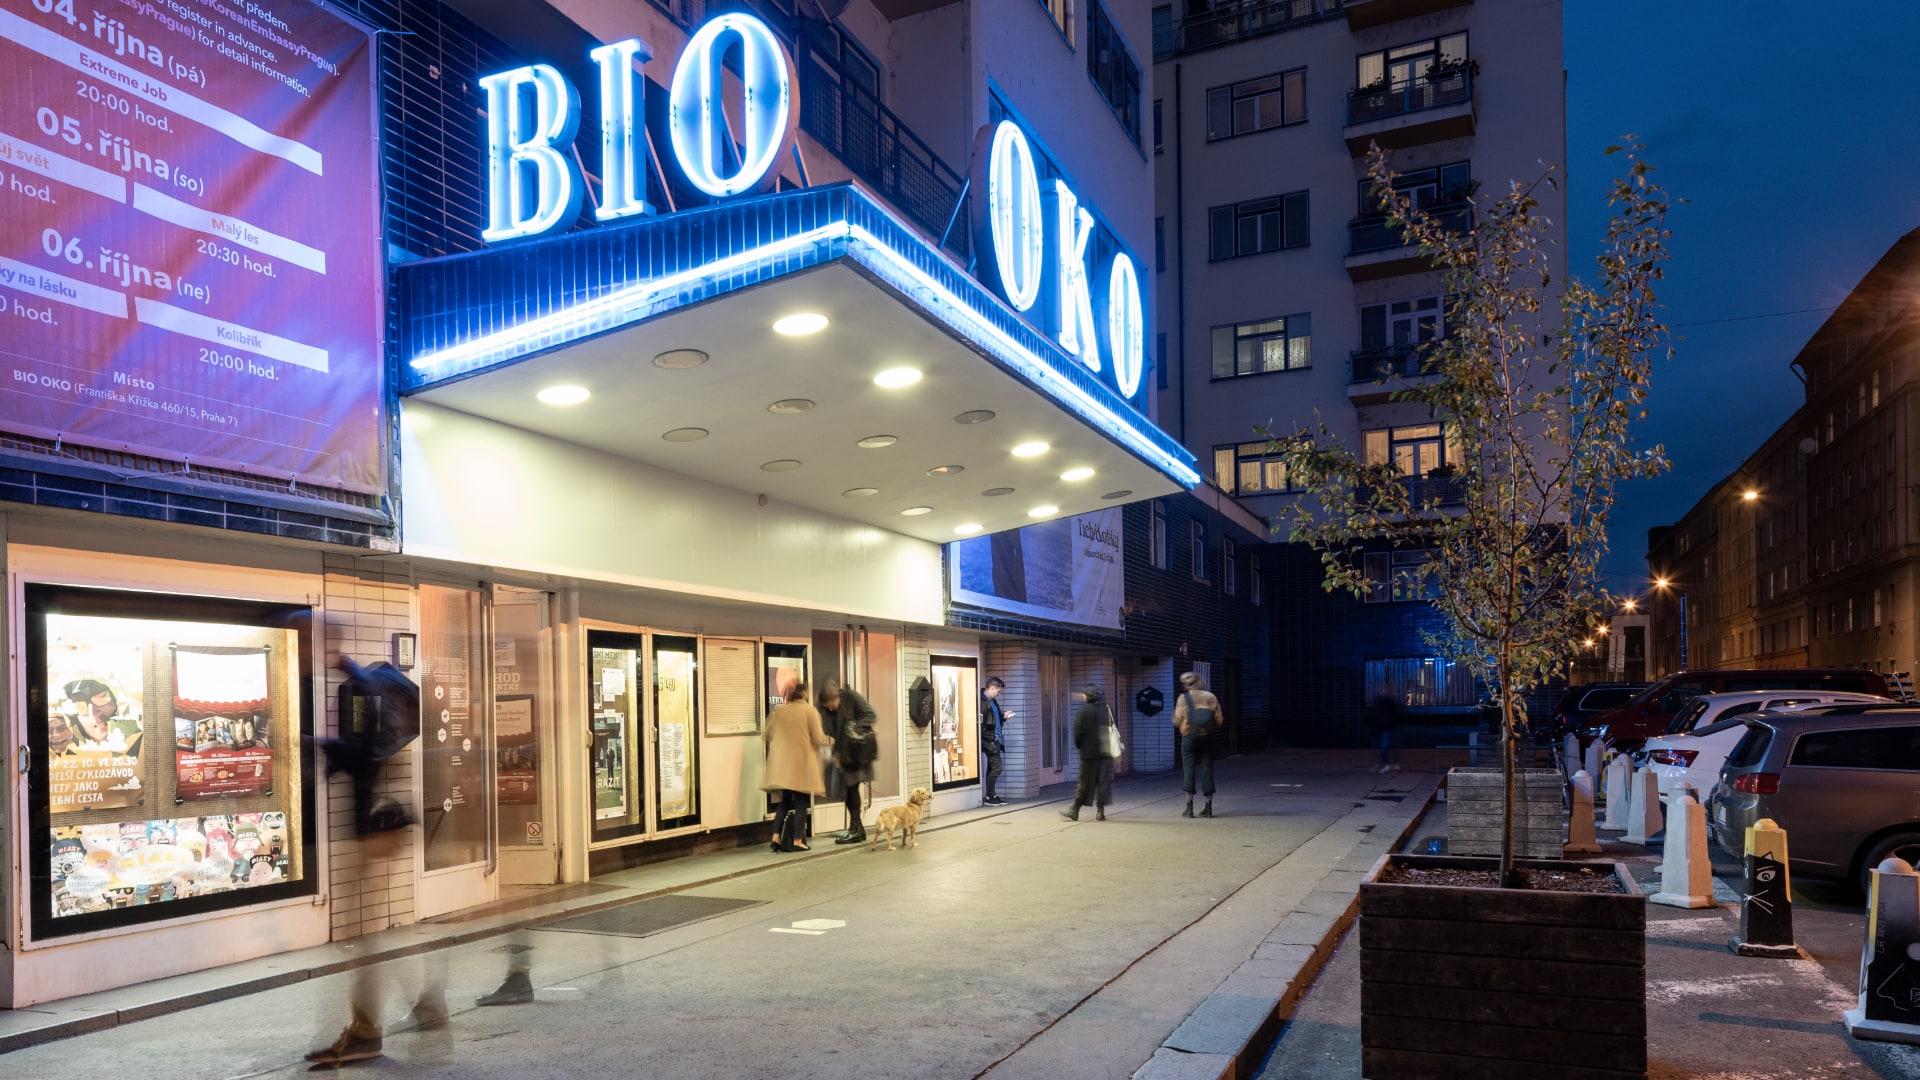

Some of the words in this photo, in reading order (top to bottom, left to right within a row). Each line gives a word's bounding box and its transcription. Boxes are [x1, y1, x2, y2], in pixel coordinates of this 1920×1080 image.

[167, 0, 213, 30] register
[214, 20, 226, 37] in
[228, 31, 278, 63] advance.
[246, 2, 292, 34] předem.
[93, 9, 164, 68] října
[168, 55, 207, 89] (pá)
[197, 29, 215, 49] for
[216, 41, 249, 67] detail
[251, 56, 312, 99] information.
[79, 51, 140, 90] Extreme
[142, 80, 168, 102] Job
[76, 80, 129, 116] 20:00
[135, 103, 174, 134] hod.
[478, 12, 797, 242] BIO
[16, 147, 50, 171] svět
[36, 106, 93, 151] 05.
[99, 129, 170, 180] října
[173, 167, 205, 198] (so)
[10, 173, 57, 205] hod.
[211, 216, 243, 240] Malý
[245, 227, 260, 246] les
[41, 227, 94, 270] 06.
[99, 246, 172, 290] října
[177, 279, 211, 305] (ne)
[196, 238, 240, 267] 20:30
[243, 259, 278, 279] hod.
[988, 118, 1144, 400] OKO
[18, 272, 37, 288] na
[39, 275, 78, 300] lásku
[13, 298, 59, 327] hod.
[216, 325, 263, 350] Kolibřík
[198, 347, 244, 373] 20:00
[248, 363, 280, 382] hod.
[113, 370, 156, 392] Místo
[13, 369, 38, 384] BIO
[41, 376, 72, 392] OKO
[74, 382, 126, 404] (Františka
[128, 393, 159, 411] Křížka
[161, 400, 200, 420] 460/15,
[201, 409, 226, 426] Praha
[227, 415, 239, 428] 7)
[495, 672, 521, 684] HOD
[496, 683, 520, 691] NTRY
[63, 759, 78, 769] 22.
[82, 758, 95, 768] 10.
[98, 757, 110, 767] VE
[112, 756, 138, 767] 20.30
[76, 768, 134, 780] CYKLOZÁVOD
[73, 781, 99, 792] JAKO
[596, 776, 620, 789] RAZIT
[52, 793, 74, 805] EBNÍ
[77, 793, 104, 803] CESTA
